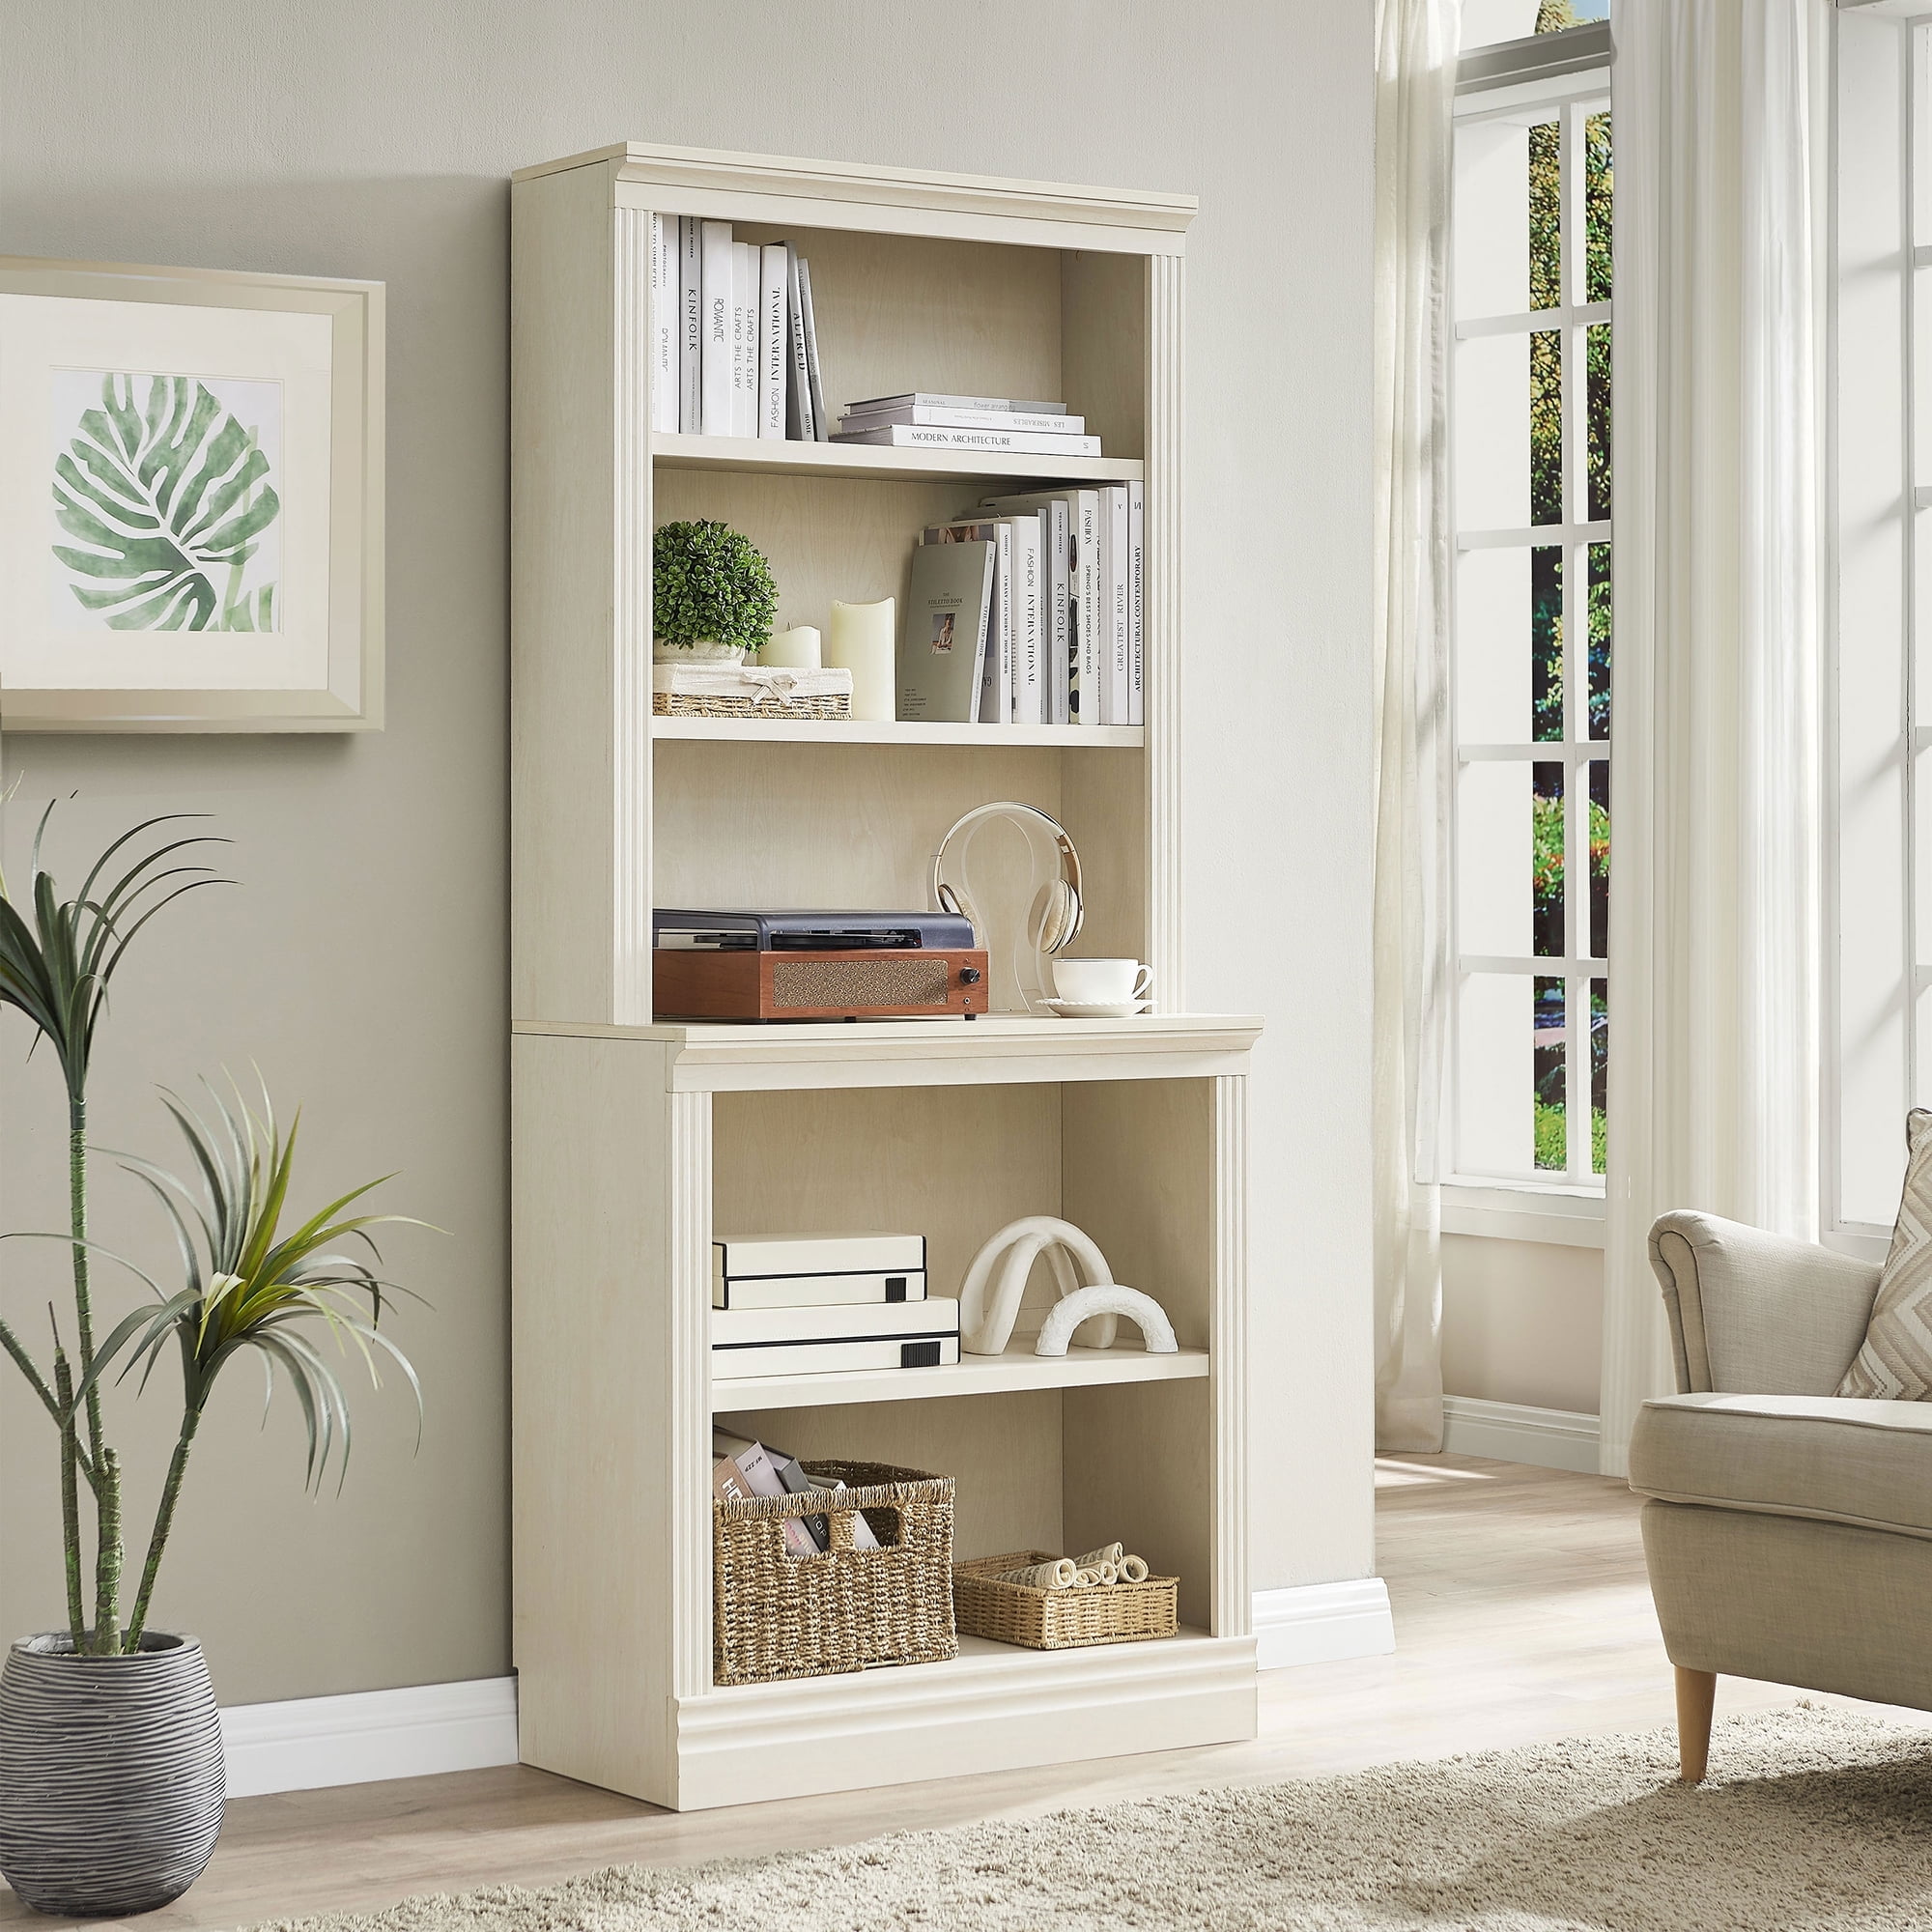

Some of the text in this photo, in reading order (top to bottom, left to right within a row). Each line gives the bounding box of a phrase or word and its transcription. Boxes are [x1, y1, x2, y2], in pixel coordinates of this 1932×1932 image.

[688, 289, 696, 351] KINFOLK
[714, 298, 724, 342] ROMANTIC
[793, 312, 806, 371] ALFRED
[771, 287, 781, 428] FASHION INTERNATIONAL
[911, 433, 1010, 445] MODERN ARCHITECTURE
[1027, 594, 1036, 686] INTERNATIONAL
